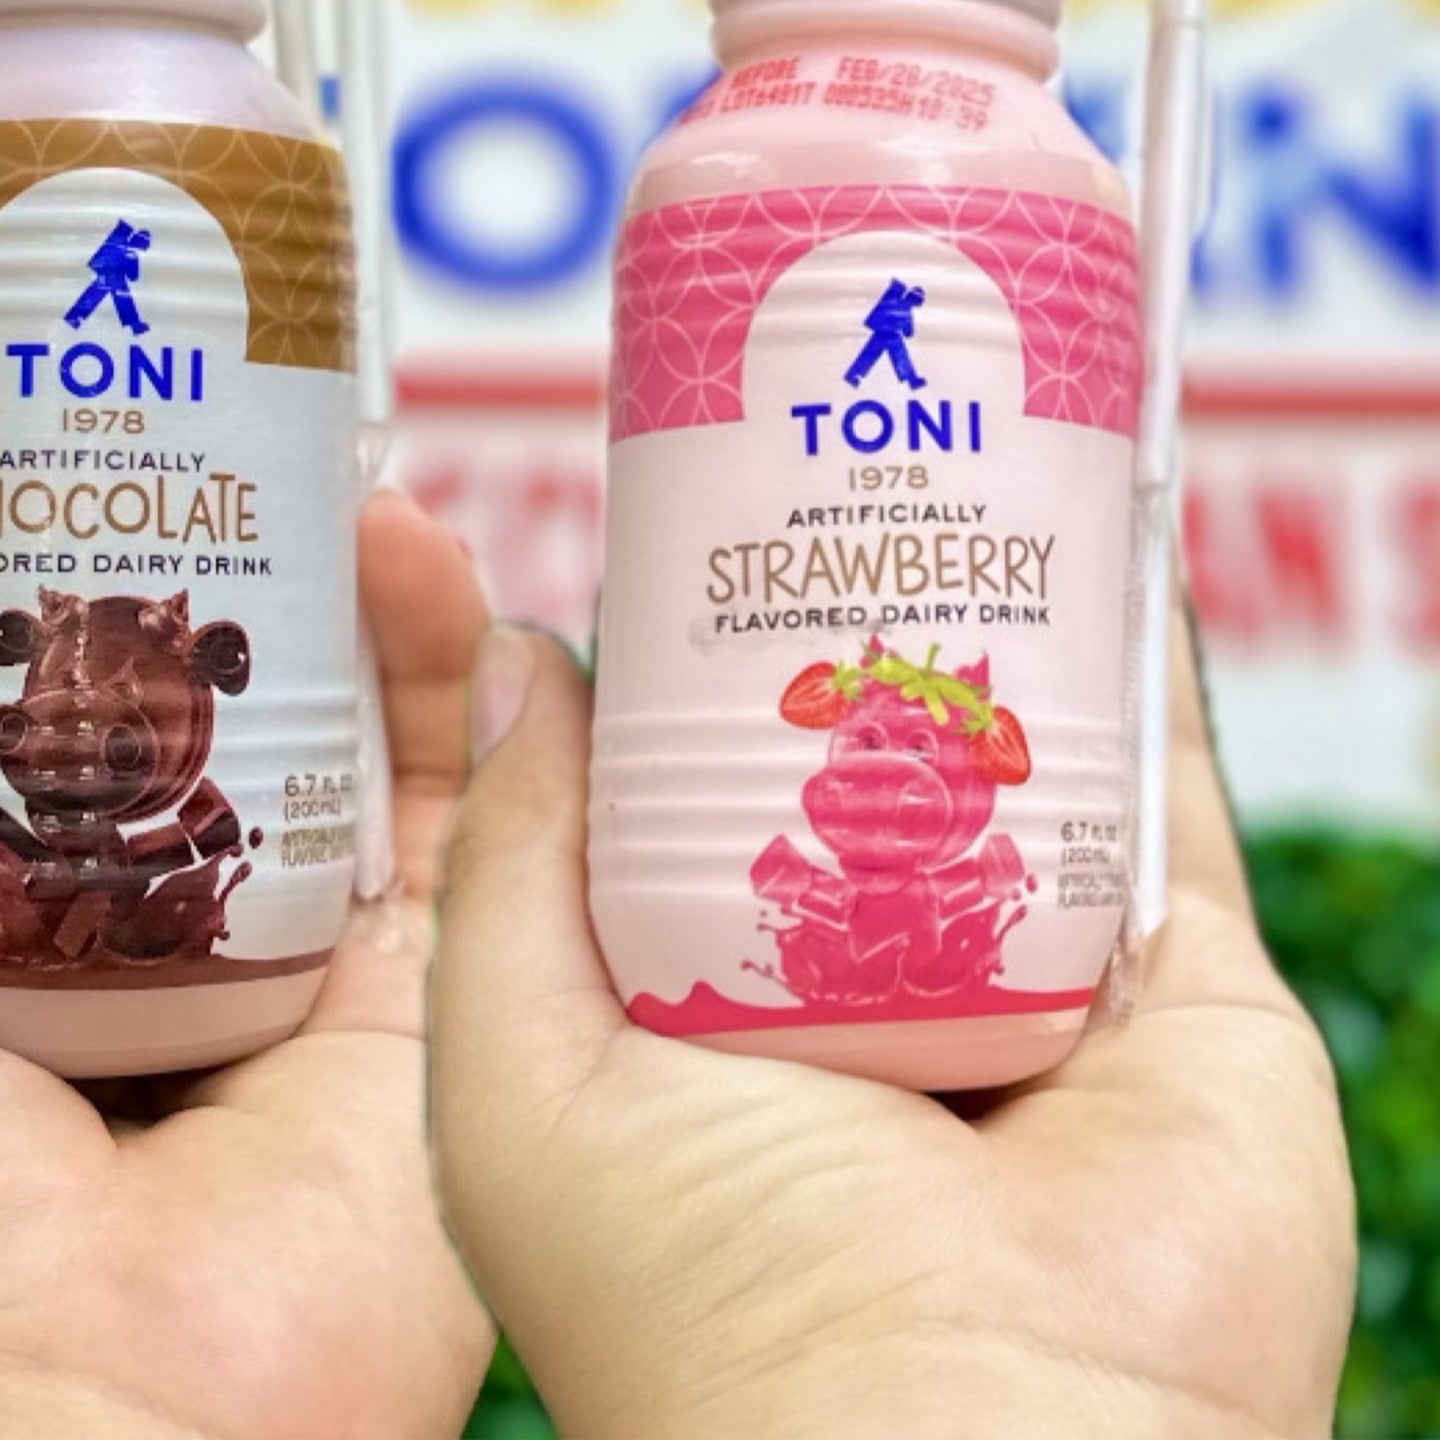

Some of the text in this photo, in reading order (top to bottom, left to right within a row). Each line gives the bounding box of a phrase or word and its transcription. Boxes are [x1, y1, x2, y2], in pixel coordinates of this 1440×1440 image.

[6, 342, 203, 401] TONI
[62, 408, 146, 435] 1978
[791, 399, 981, 456] TONI
[849, 465, 929, 491] 1978
[786, 504, 987, 528] ARTIFICIALLY
[93, 554, 184, 575] DAIRY
[196, 555, 272, 576] DRINK
[706, 531, 1055, 605] STRAWBERRY
[715, 604, 1050, 634] FLAVORED DAIRY DRINK
